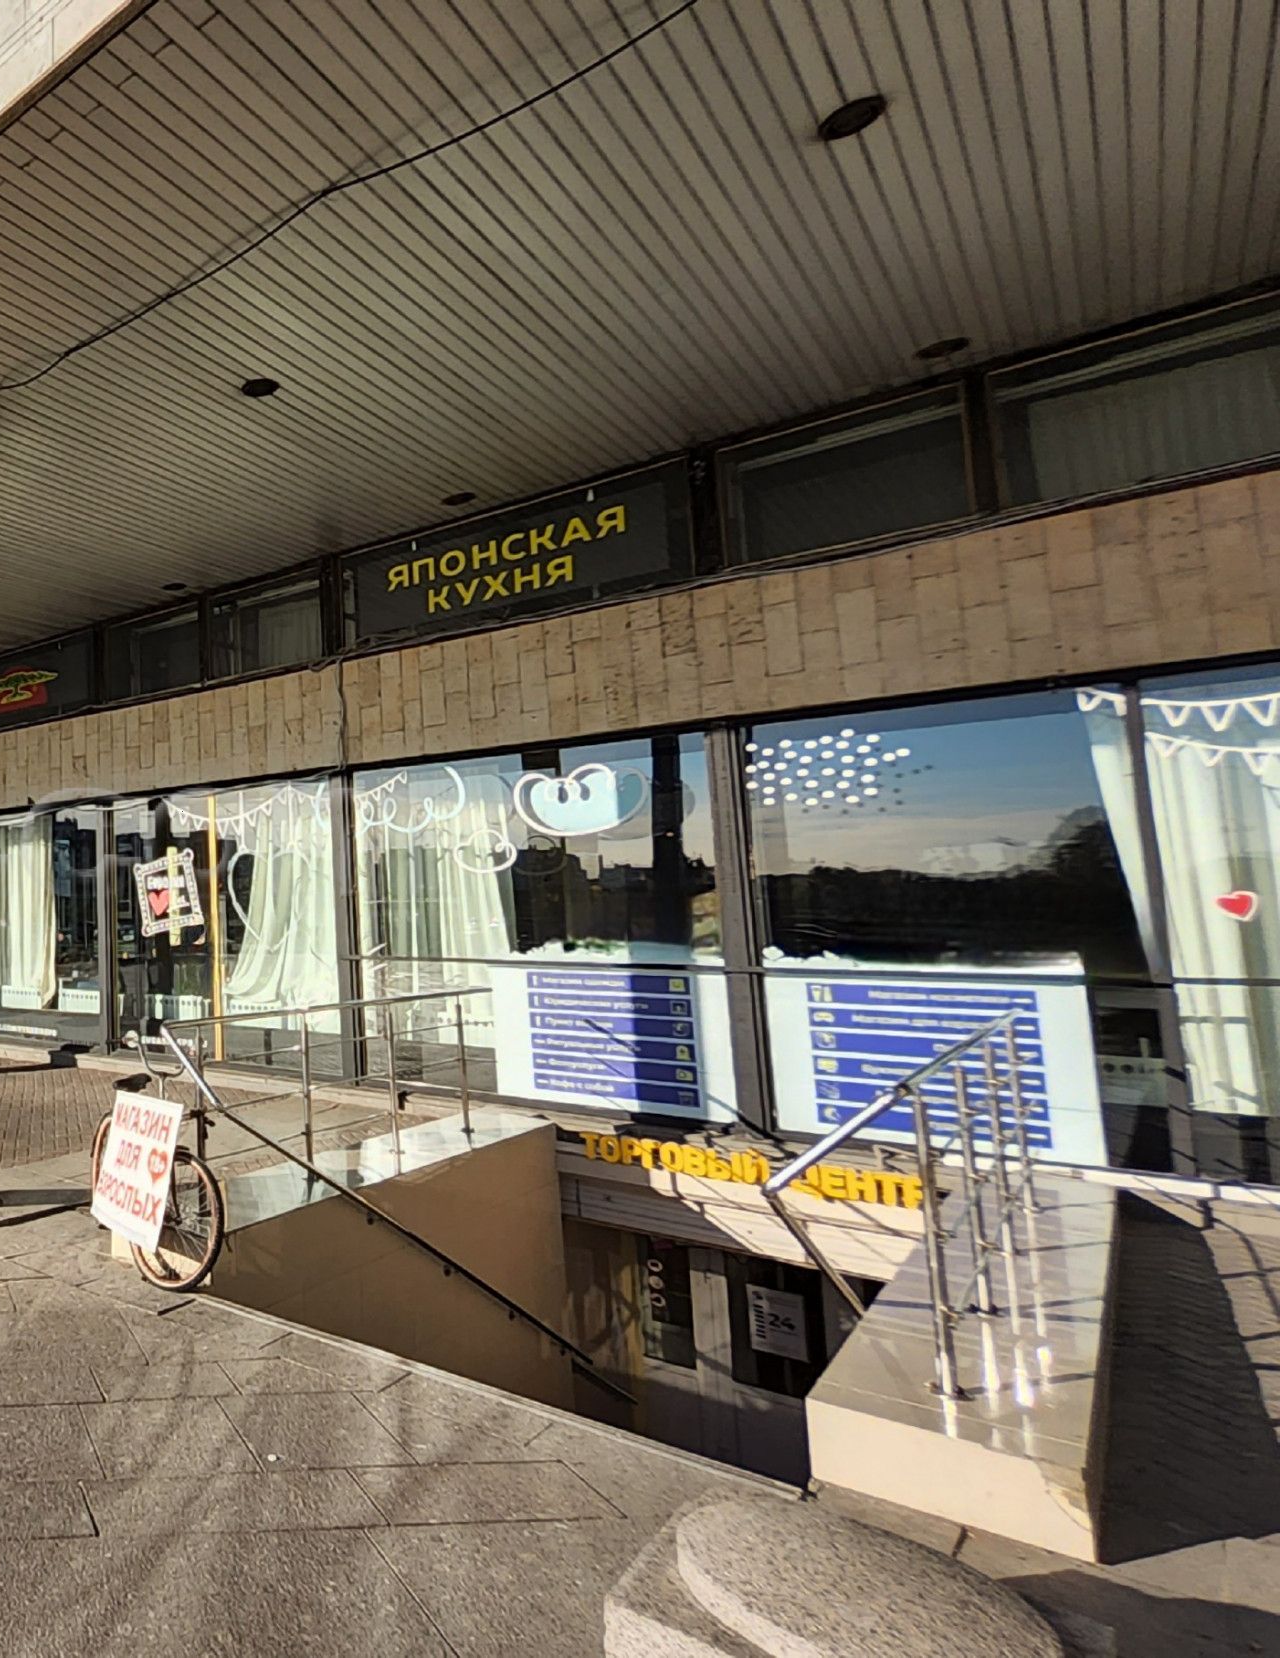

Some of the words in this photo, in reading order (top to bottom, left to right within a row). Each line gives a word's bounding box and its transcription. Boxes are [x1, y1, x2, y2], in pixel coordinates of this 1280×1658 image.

[387, 505, 626, 592] ЯПОНСКАЯ
[427, 555, 574, 614] КУХНЯ
[116, 1104, 173, 1144] МАГАЗИН
[116, 1141, 143, 1170] ДЛЯ
[580, 1131, 770, 1185] ТОРГОВЫЙ
[766, 1312, 797, 1332] 24
